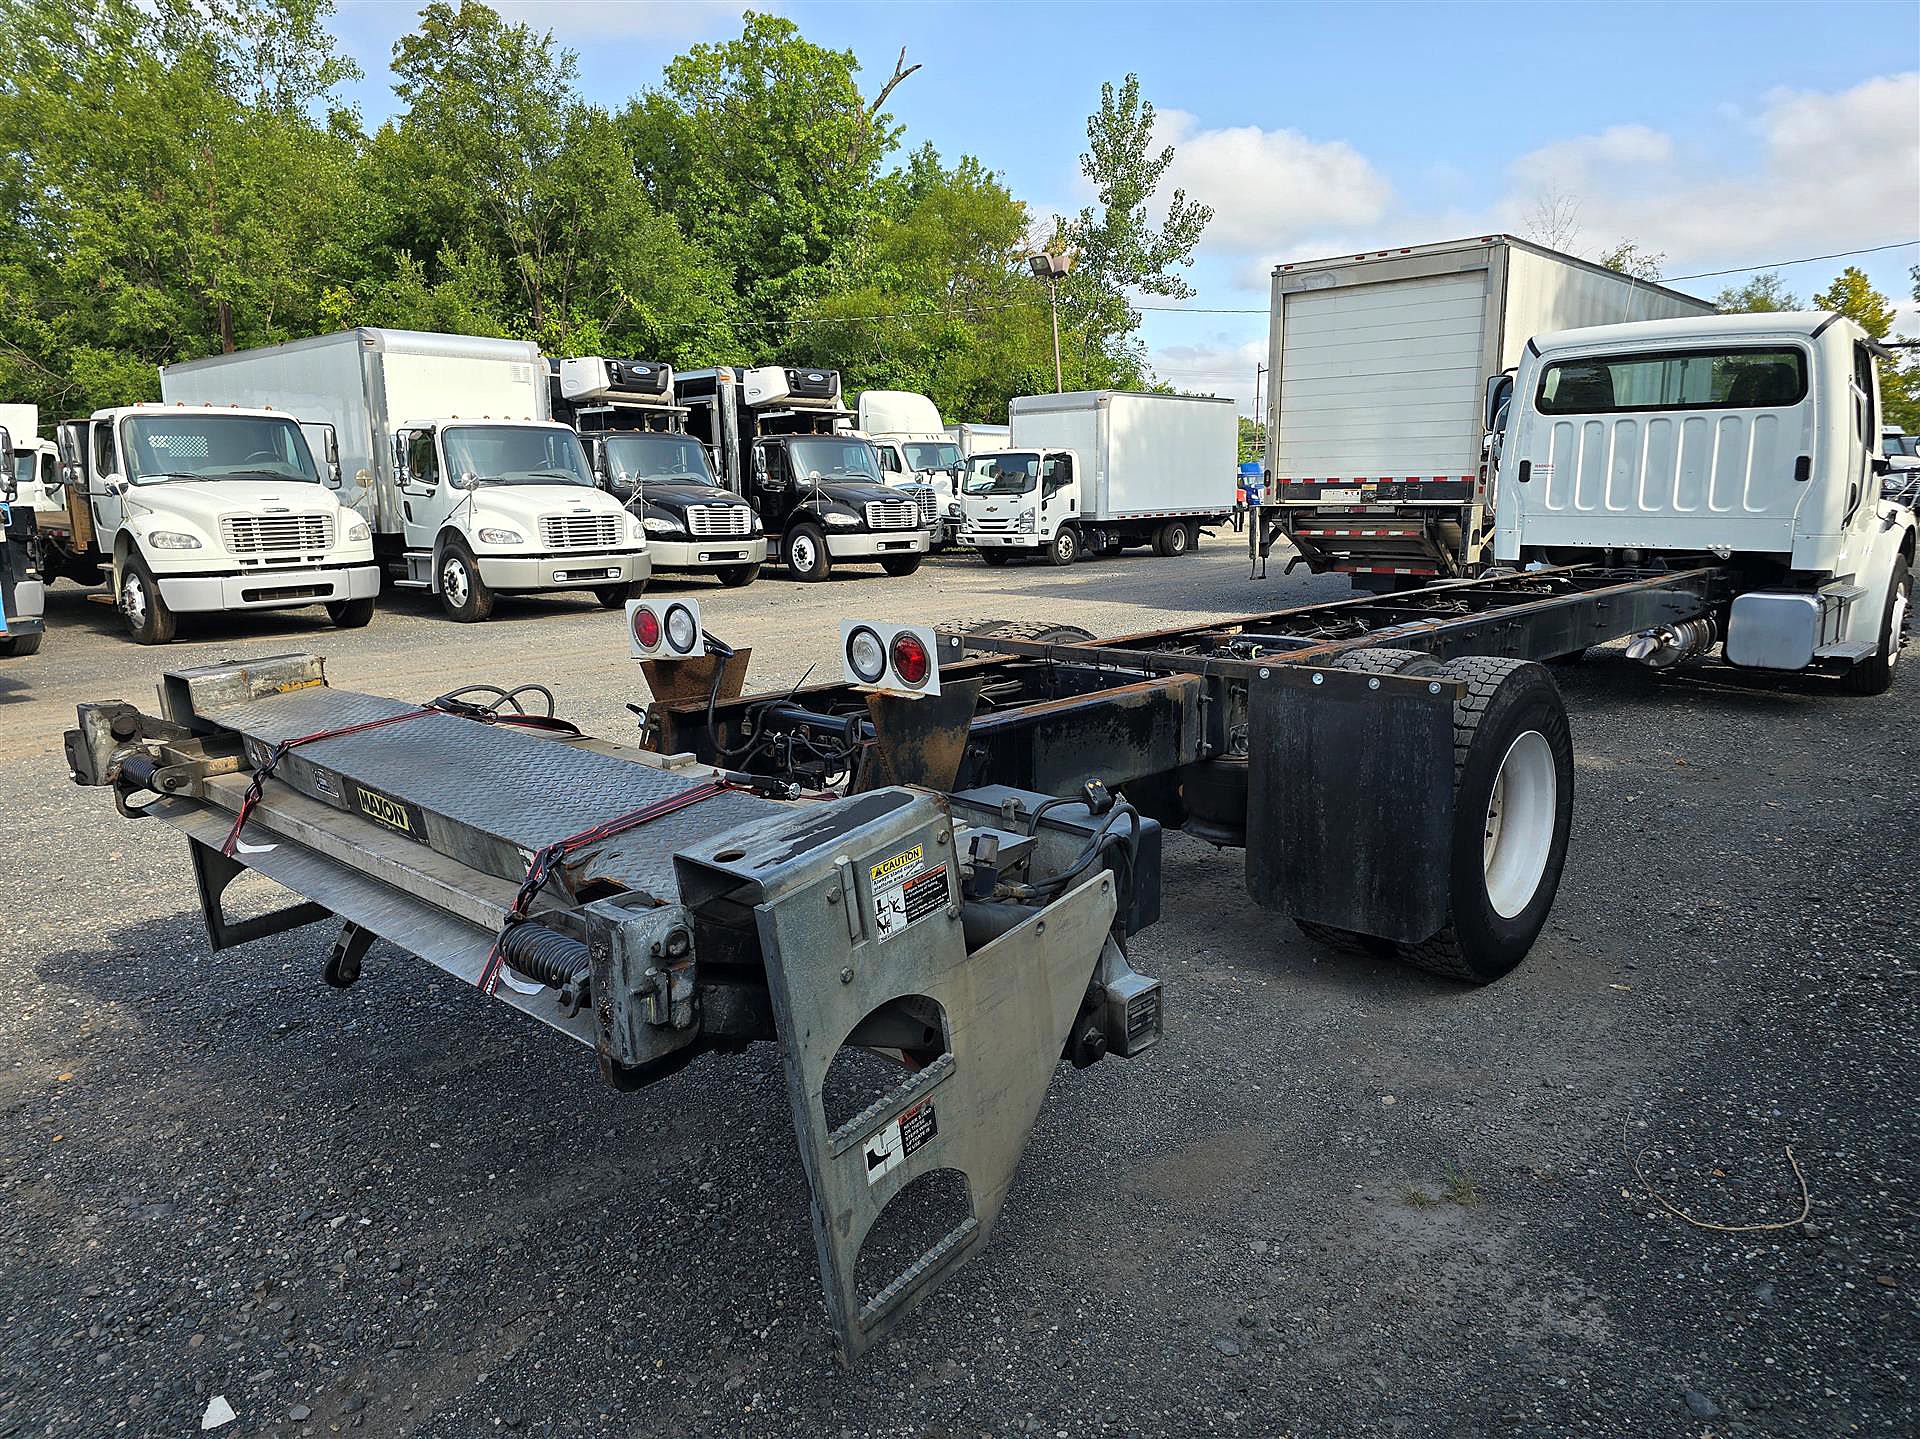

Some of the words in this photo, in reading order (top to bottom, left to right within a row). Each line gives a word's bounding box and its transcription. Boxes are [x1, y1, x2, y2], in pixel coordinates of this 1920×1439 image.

[358, 789, 406, 827] MAXON
[883, 849, 919, 872] CAUTION
[903, 1117, 918, 1130] NEVER
[904, 1128, 911, 1136] ON
[905, 1129, 919, 1142] STEPS
